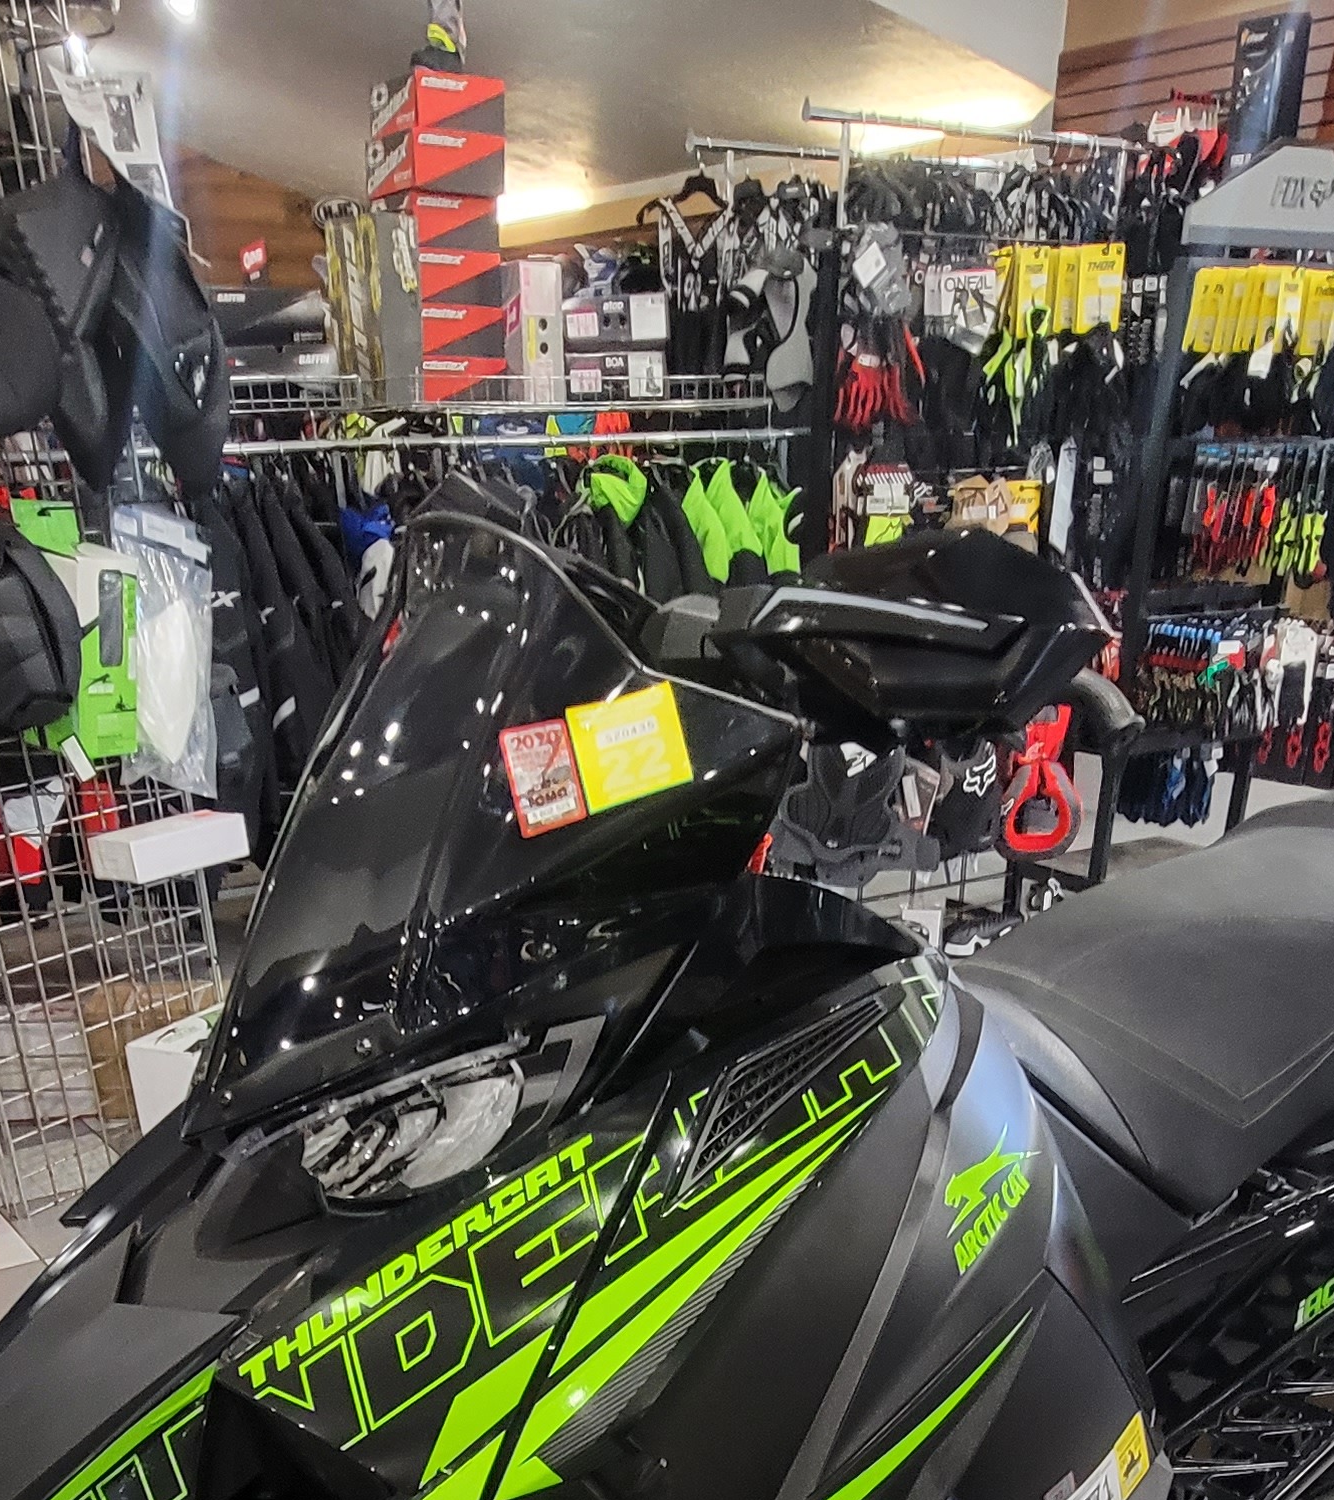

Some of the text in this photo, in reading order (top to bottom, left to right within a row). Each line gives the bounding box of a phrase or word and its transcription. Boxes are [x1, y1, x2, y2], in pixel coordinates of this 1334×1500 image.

[1087, 260, 1116, 271] THOR
[298, 354, 329, 365] BAFFIN
[605, 357, 624, 368] BOA
[597, 738, 672, 798] 22
[953, 1161, 1031, 1276] ARCTIC CAT
[238, 1133, 593, 1389] THUNDERCAT
